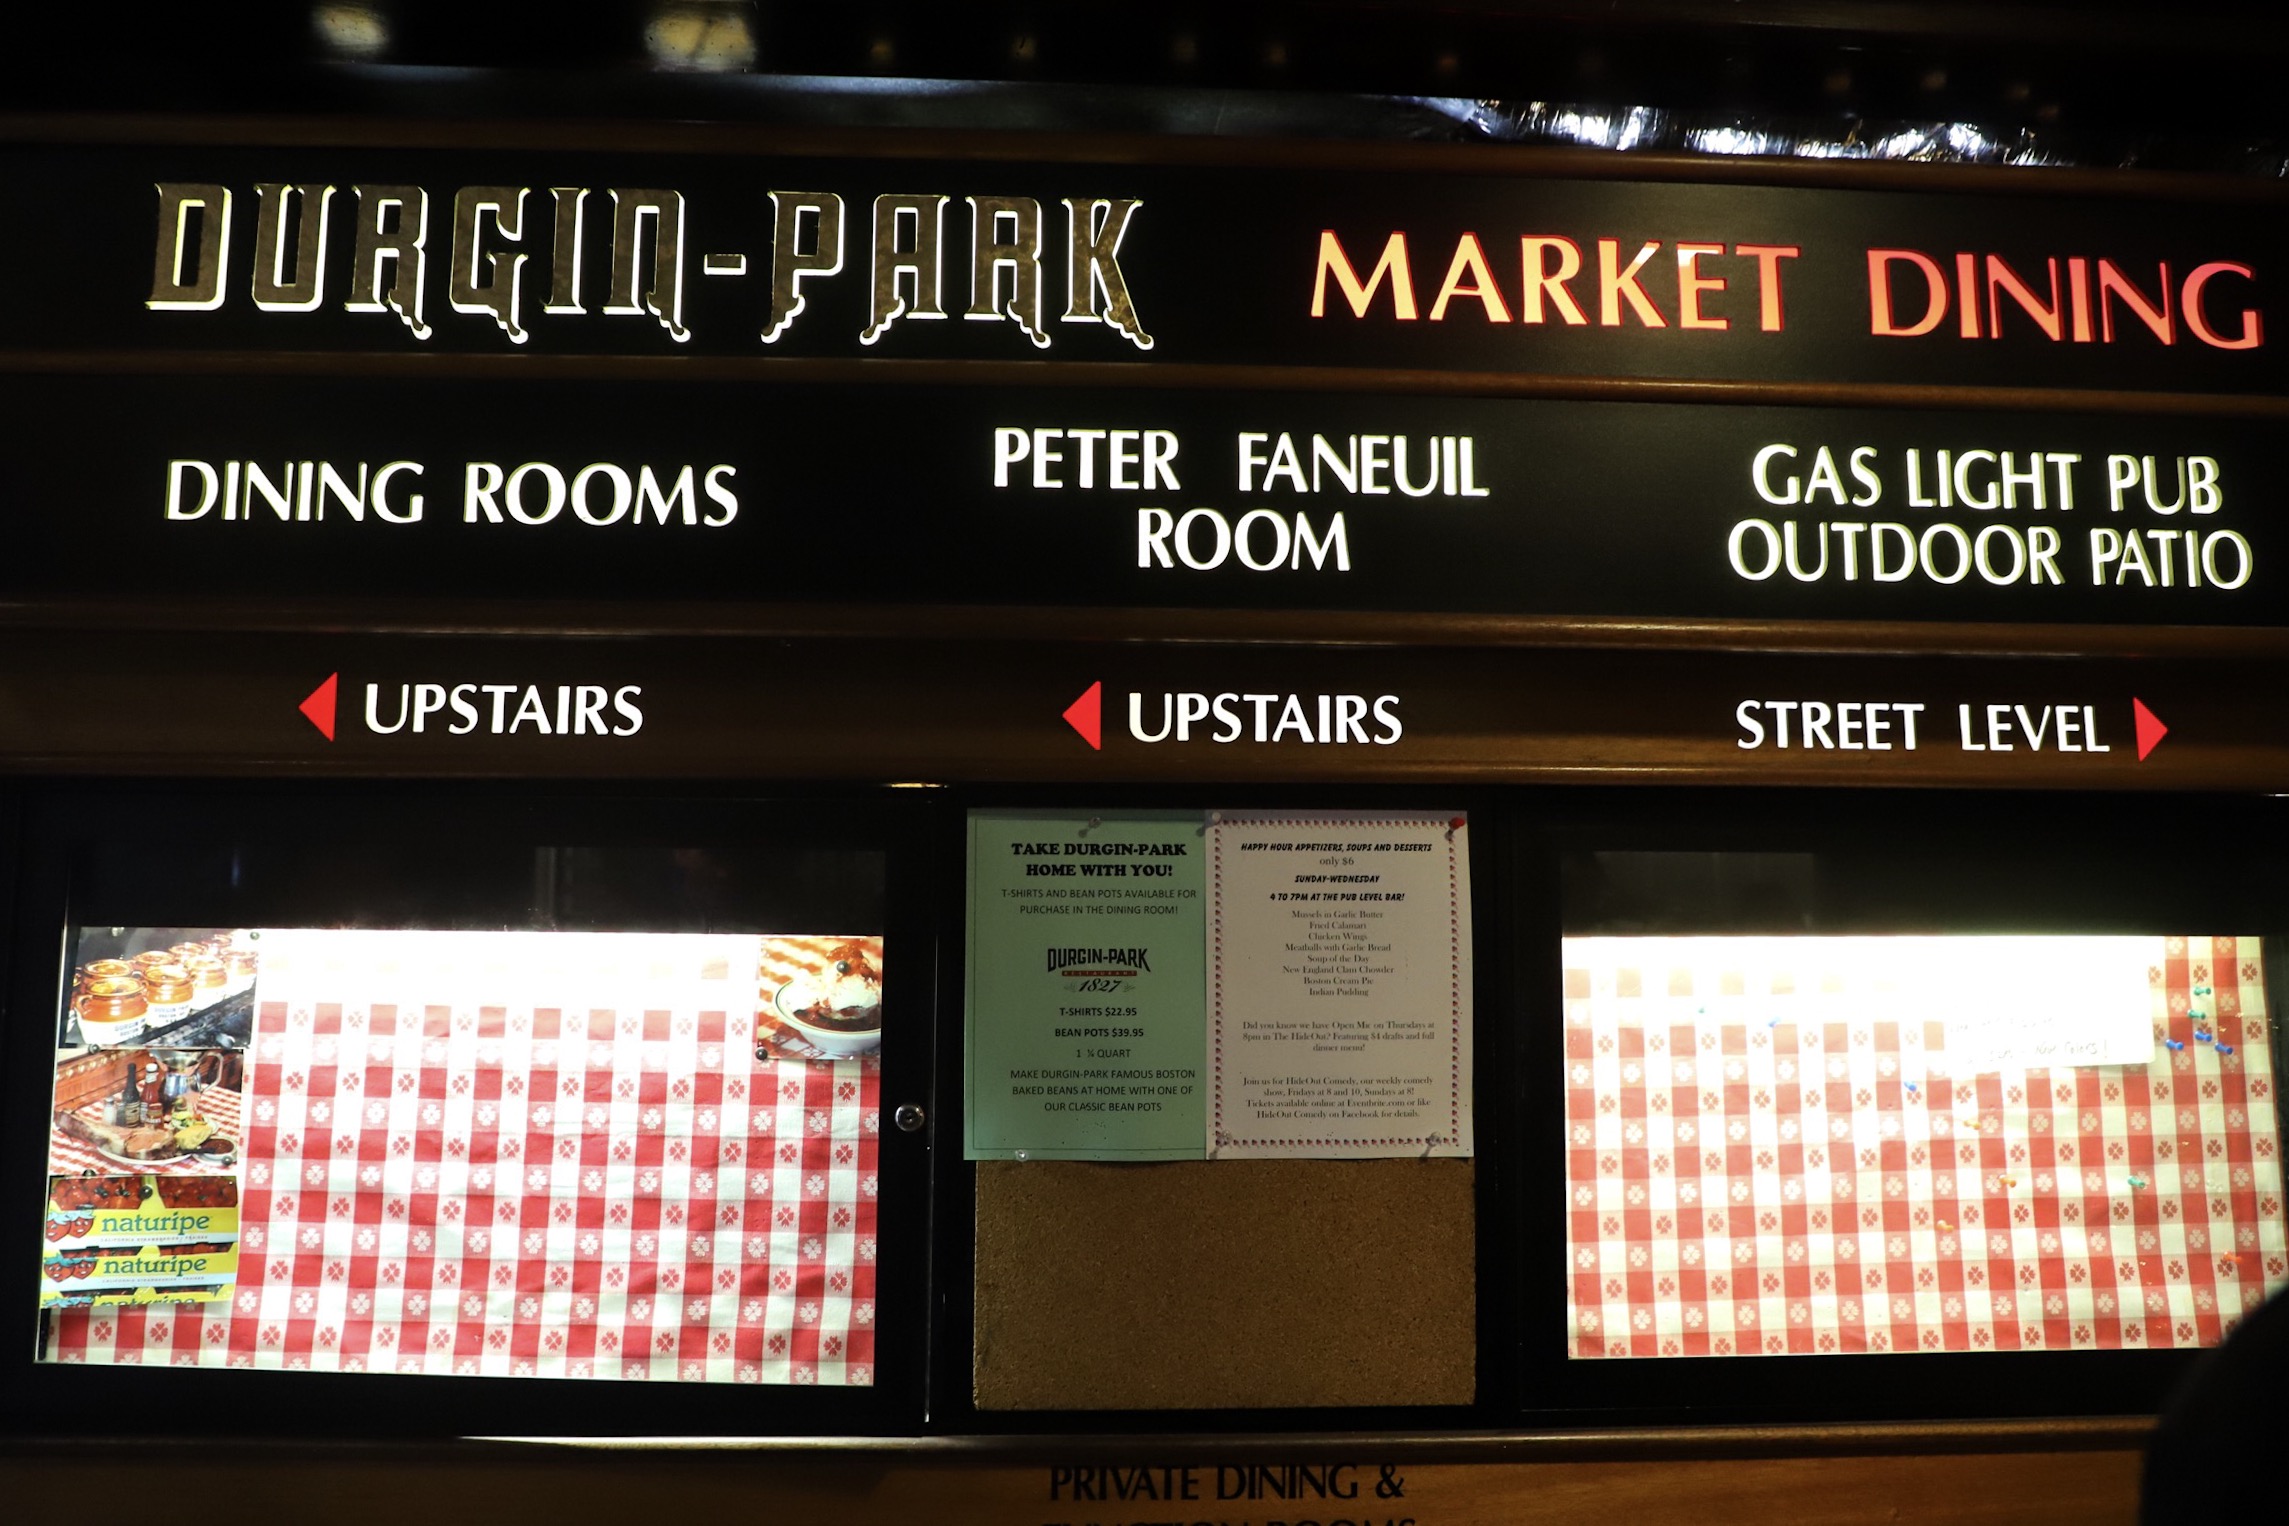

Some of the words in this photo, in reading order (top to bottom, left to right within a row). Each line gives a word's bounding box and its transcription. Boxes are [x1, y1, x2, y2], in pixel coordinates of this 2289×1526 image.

[144, 183, 1155, 351] DURGIN-PARK
[1310, 231, 1799, 333] MARKET
[1867, 249, 2259, 350] DINING
[993, 427, 1181, 491] PETER
[1238, 431, 1491, 498] FANEUIL
[1751, 443, 1882, 508] GAS
[1905, 448, 2082, 511] LIGHT
[2107, 454, 2223, 516] PUB
[165, 459, 425, 524] DINING
[463, 461, 739, 528] ROOMS
[1137, 507, 1351, 572] ROOM
[1727, 518, 2065, 586] OUTDOOR
[2089, 527, 2253, 590] PATIO
[365, 683, 644, 737] UPSTAIRS
[1128, 692, 1403, 745] UPSTAIRS
[1735, 699, 1925, 751] STREET
[1958, 703, 2111, 753] LEVEL
[1011, 843, 1060, 855] TAKE
[1064, 844, 1187, 855] DURGIN-PARK
[1241, 843, 1268, 851] HAPPY
[1270, 843, 1293, 851] HOUR
[1295, 843, 1344, 852] APPETIZERS,
[1320, 856, 1339, 867] only
[1342, 857, 1354, 865] $6
[1026, 864, 1076, 876] HOME
[1080, 864, 1126, 876] WITH
[1130, 865, 1172, 876] YOU!
[1295, 875, 1379, 883] SUNDAY-WEDNESDAY
[1001, 889, 1044, 898] T-SHIRTS
[1046, 889, 1067, 898] AND
[1070, 889, 1095, 898] BEAN
[1098, 890, 1122, 898] POTS
[1125, 890, 1174, 898] AVAILABLE
[1178, 890, 1196, 898] FOR
[1278, 893, 1288, 901] TO
[1323, 893, 1338, 901] THE
[1341, 893, 1357, 901] PUB
[1360, 893, 1382, 901] LEVEL
[1385, 893, 1404, 901] BAR!
[1020, 905, 1069, 914] PURCHASE
[1073, 906, 1083, 914] IN
[1086, 906, 1103, 914] THE
[1107, 906, 1140, 914] DINING
[1144, 906, 1177, 914] ROOM!
[1292, 910, 1322, 918] Mussels
[1333, 910, 1356, 918] Garlic
[1310, 921, 1329, 929] Fried
[1332, 921, 1366, 929] Calamari
[1308, 932, 1340, 940] Chicken
[1343, 932, 1367, 941] Wings
[1048, 948, 1151, 973] DURGIN-PARK
[1302, 966, 1334, 974] England
[1079, 978, 1122, 992] 1827
[1337, 988, 1368, 996] Pudding
[1059, 1008, 1102, 1016] T-SHIRTS
[1105, 1007, 1137, 1017] $22.95
[1276, 1021, 1298, 1029] know
[1311, 1021, 1330, 1029] have
[1332, 1022, 1355, 1030] Open
[1356, 1021, 1371, 1029] Mic
[1387, 1021, 1426, 1029] Thursdays
[1055, 1028, 1081, 1037] BEAN
[1084, 1029, 1109, 1037] POTS
[1112, 1028, 1143, 1037] $39.95
[1313, 1043, 1338, 1051] dinner
[1077, 1049, 1081, 1058] 1
[1097, 1049, 1131, 1058] QUART
[1011, 1070, 1038, 1079] MAKE
[1041, 1070, 1108, 1079] DURGIN-PARK
[1111, 1070, 1153, 1078] FAMOUS
[1242, 1077, 1260, 1086] Join
[1286, 1077, 1321, 1085] HideOut
[1323, 1077, 1358, 1085] Comedy,
[1403, 1077, 1433, 1085] comedy
[1013, 1086, 1044, 1095] BAKED
[1047, 1086, 1078, 1095] BEANS
[1081, 1086, 1094, 1095] AT
[1096, 1086, 1126, 1095] HOME
[1129, 1086, 1154, 1095] WITH
[1158, 1086, 1177, 1095] ONE
[1181, 1086, 1192, 1094] OF
[1263, 1088, 1286, 1096] show,
[1365, 1088, 1396, 1096] Sundays
[1045, 1102, 1065, 1111] OUR
[1069, 1102, 1105, 1111] CLASSIC
[1109, 1103, 1134, 1111] BEAN
[1138, 1103, 1161, 1111] POTS
[1276, 1099, 1309, 1107] available
[1417, 1098, 1431, 1106] like
[1293, 1110, 1327, 1118] Comedy
[1341, 1110, 1379, 1118] Facebook
[1381, 1110, 1392, 1118] for
[102, 1212, 209, 1235] naturipe
[104, 1256, 207, 1277] naturipe
[1050, 1465, 1199, 1500] PRIVATE
[1217, 1464, 1358, 1500] DINING
[1376, 1462, 1404, 1499] &
